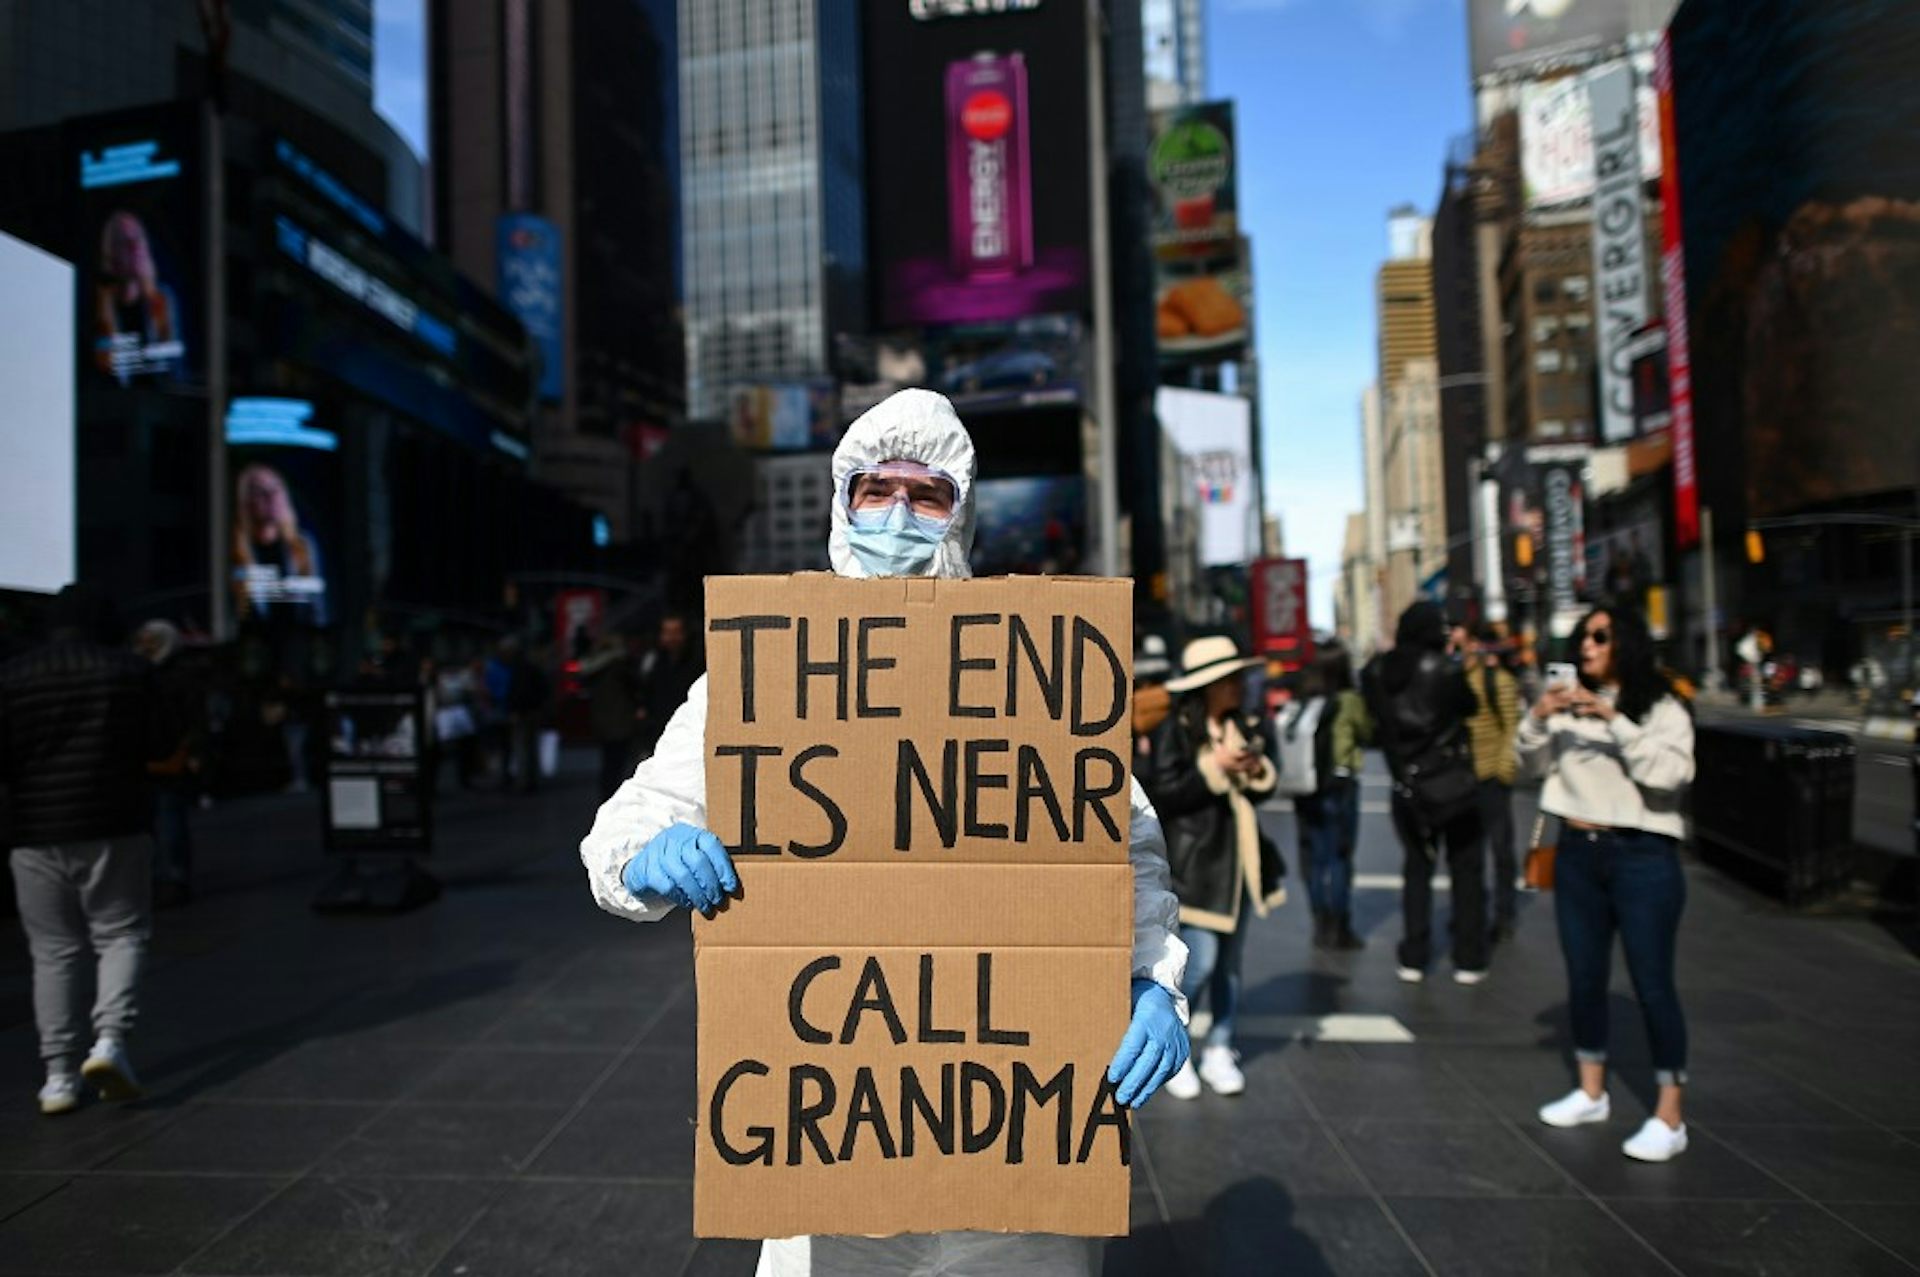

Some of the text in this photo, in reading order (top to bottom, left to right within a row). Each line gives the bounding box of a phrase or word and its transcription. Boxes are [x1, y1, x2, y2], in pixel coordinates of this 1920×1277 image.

[969, 140, 1000, 257] ENERGY
[1596, 108, 1642, 418] COVERGIRL
[709, 613, 1127, 736] THE END
[715, 739, 1125, 858] IS NEAR
[788, 953, 1029, 1045] CALL
[710, 1059, 1130, 1166] GRANDMA
